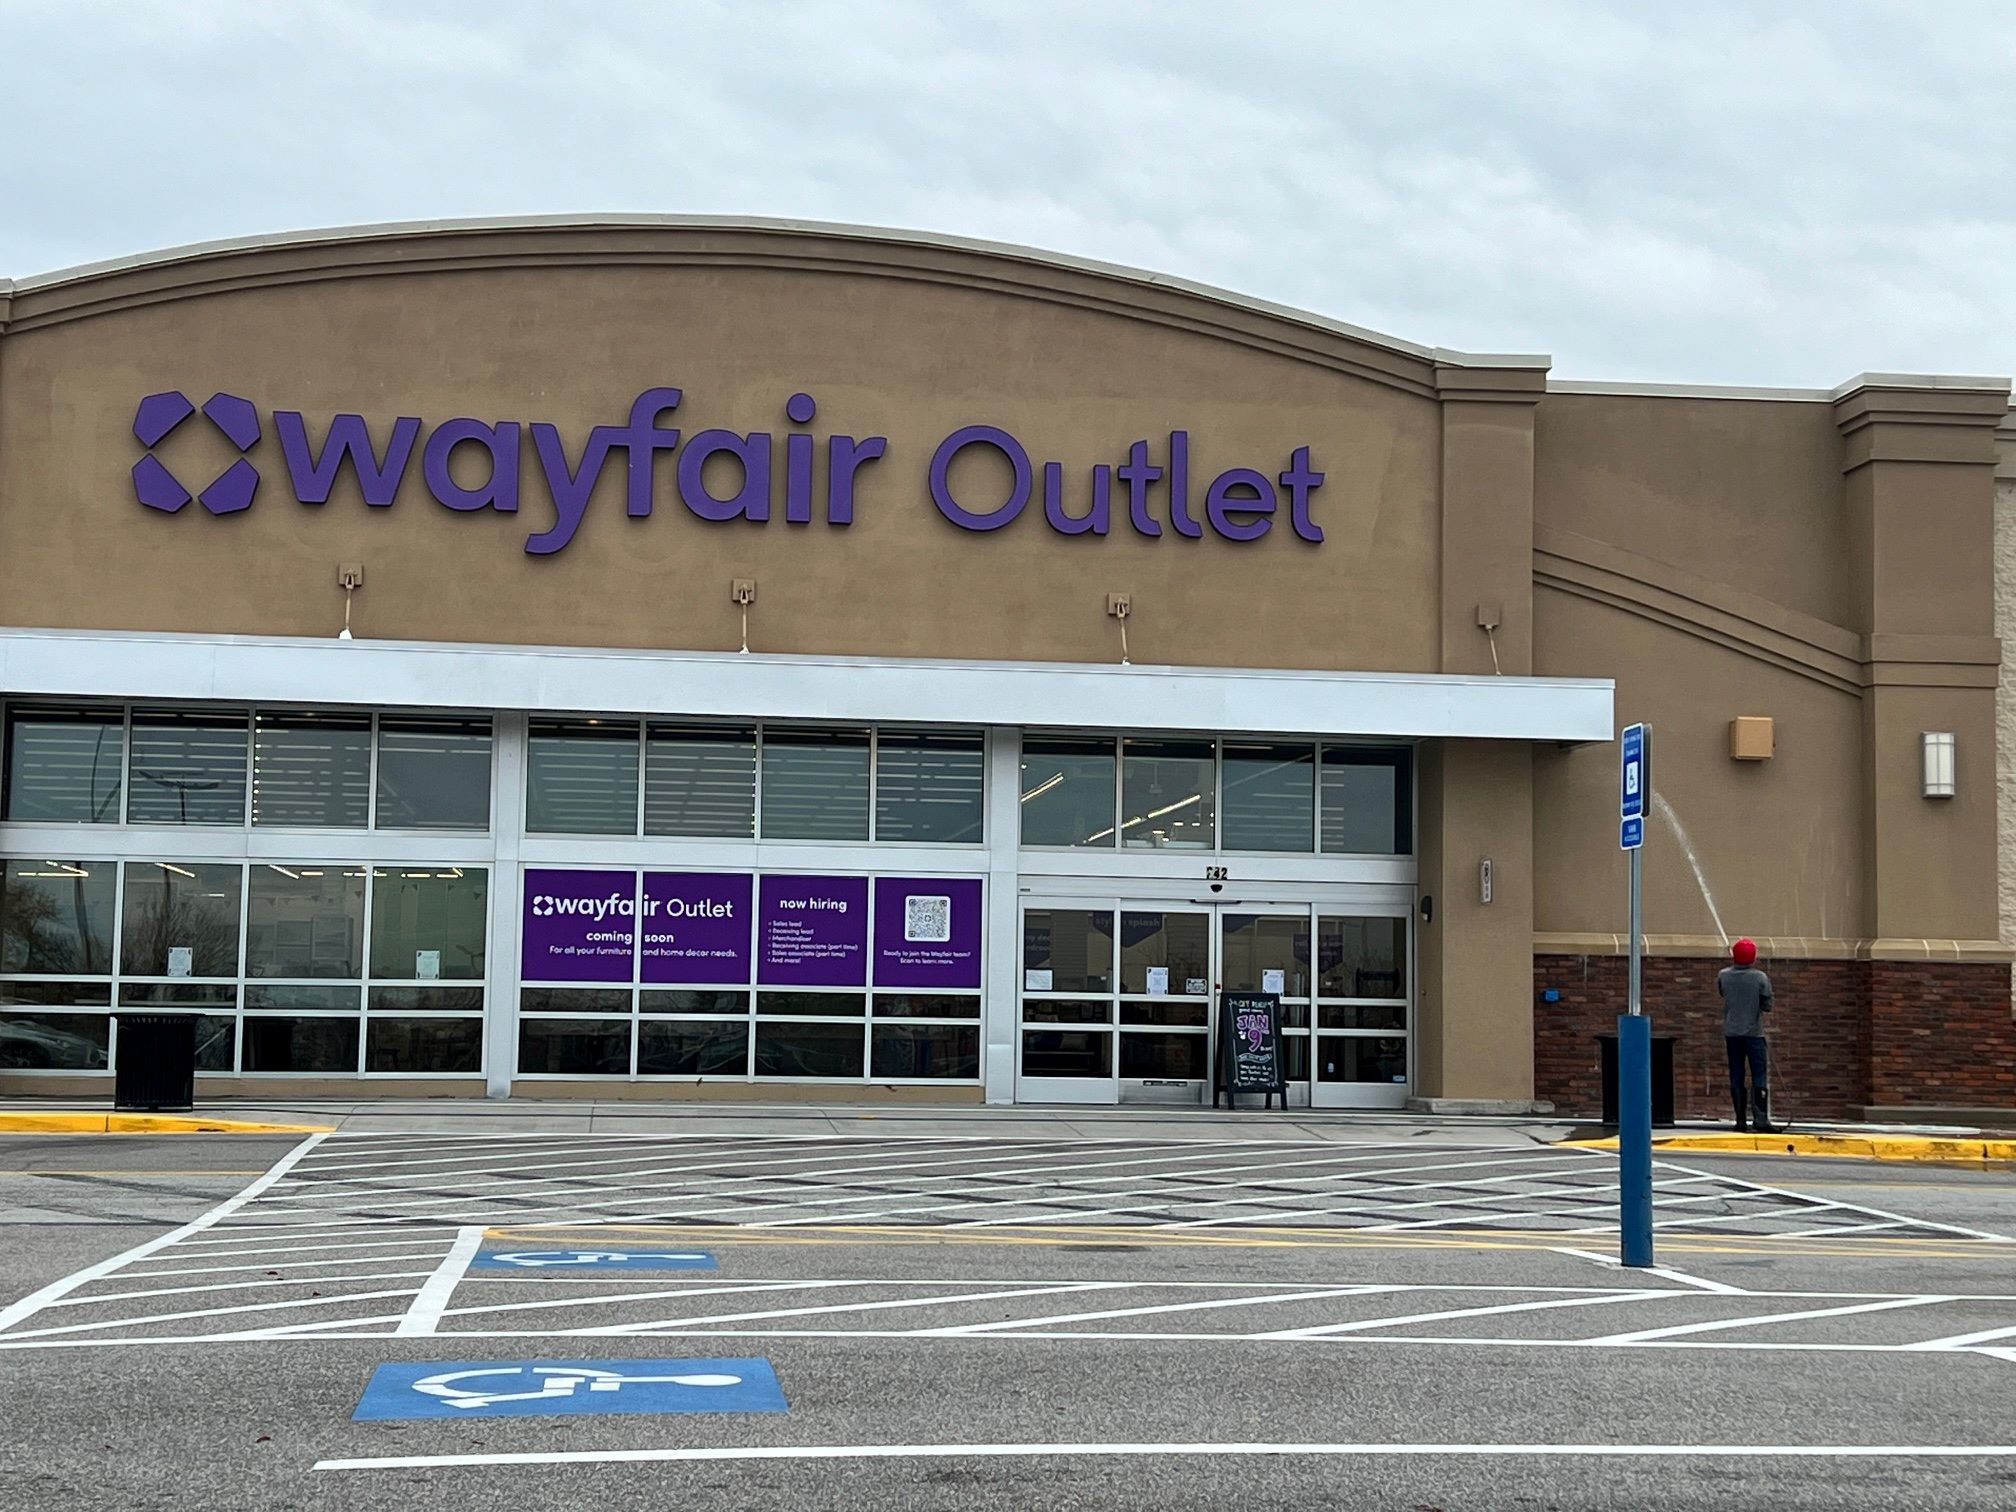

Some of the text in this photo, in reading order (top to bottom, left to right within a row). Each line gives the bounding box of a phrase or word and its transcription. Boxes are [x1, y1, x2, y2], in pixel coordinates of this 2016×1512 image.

[273, 387, 1326, 555] wayfair Outlet
[555, 893, 734, 921] wayfair Outlet
[779, 897, 848, 913] now hiring
[586, 930, 674, 945] coming soon
[549, 945, 738, 958] For all your furniture and home decor needs.
[1236, 1014, 1269, 1030] JAN
